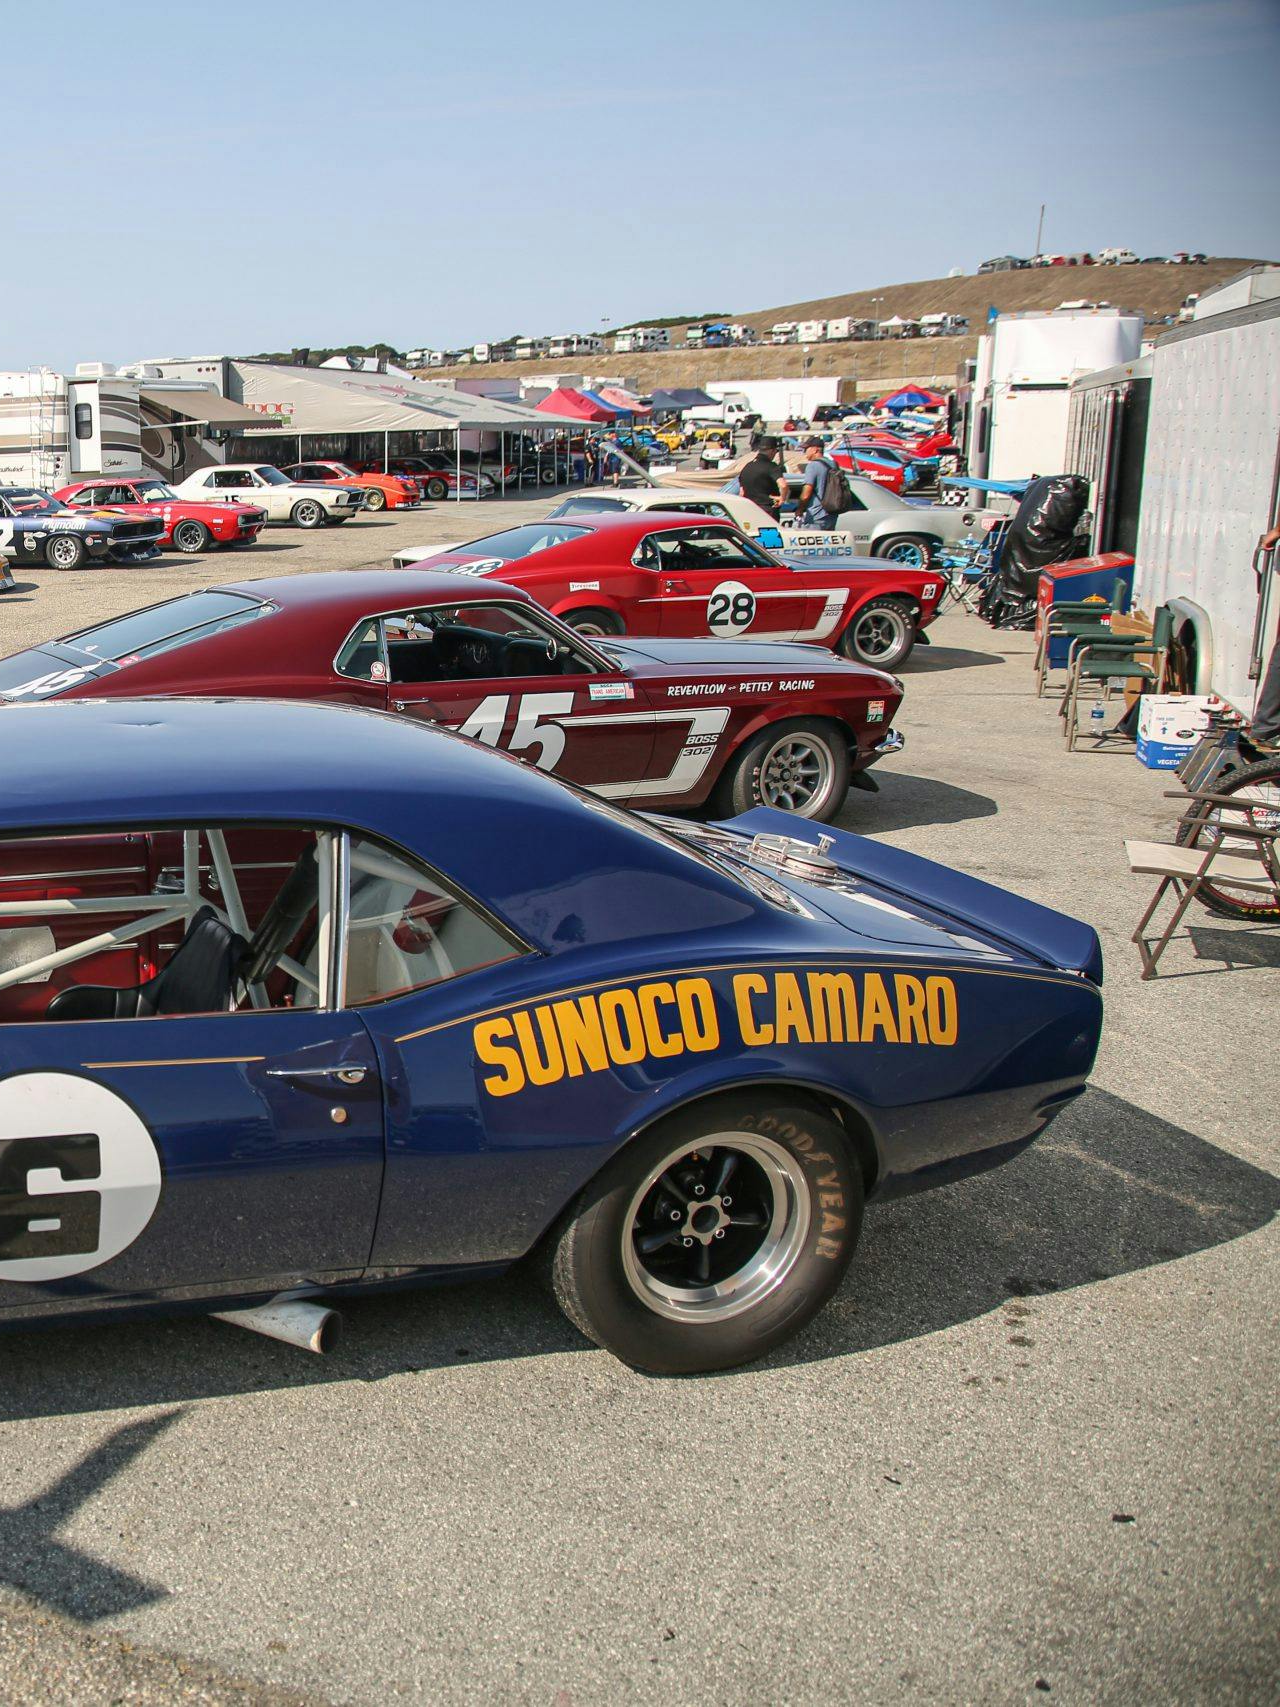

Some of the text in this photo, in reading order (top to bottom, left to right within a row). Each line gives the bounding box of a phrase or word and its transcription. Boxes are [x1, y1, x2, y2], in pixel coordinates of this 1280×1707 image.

[41, 518, 86, 533] Plymouth
[790, 535, 847, 546] KODEKEY
[708, 592, 755, 627] 28
[667, 679, 816, 698] REVENTLOW PETTEY RACING
[457, 691, 575, 772] 45
[686, 733, 720, 745] BOSS
[682, 745, 714, 757] 302
[473, 971, 959, 1097] SUNOCO CAMARO
[737, 1113, 847, 1260] GOODYEAR
